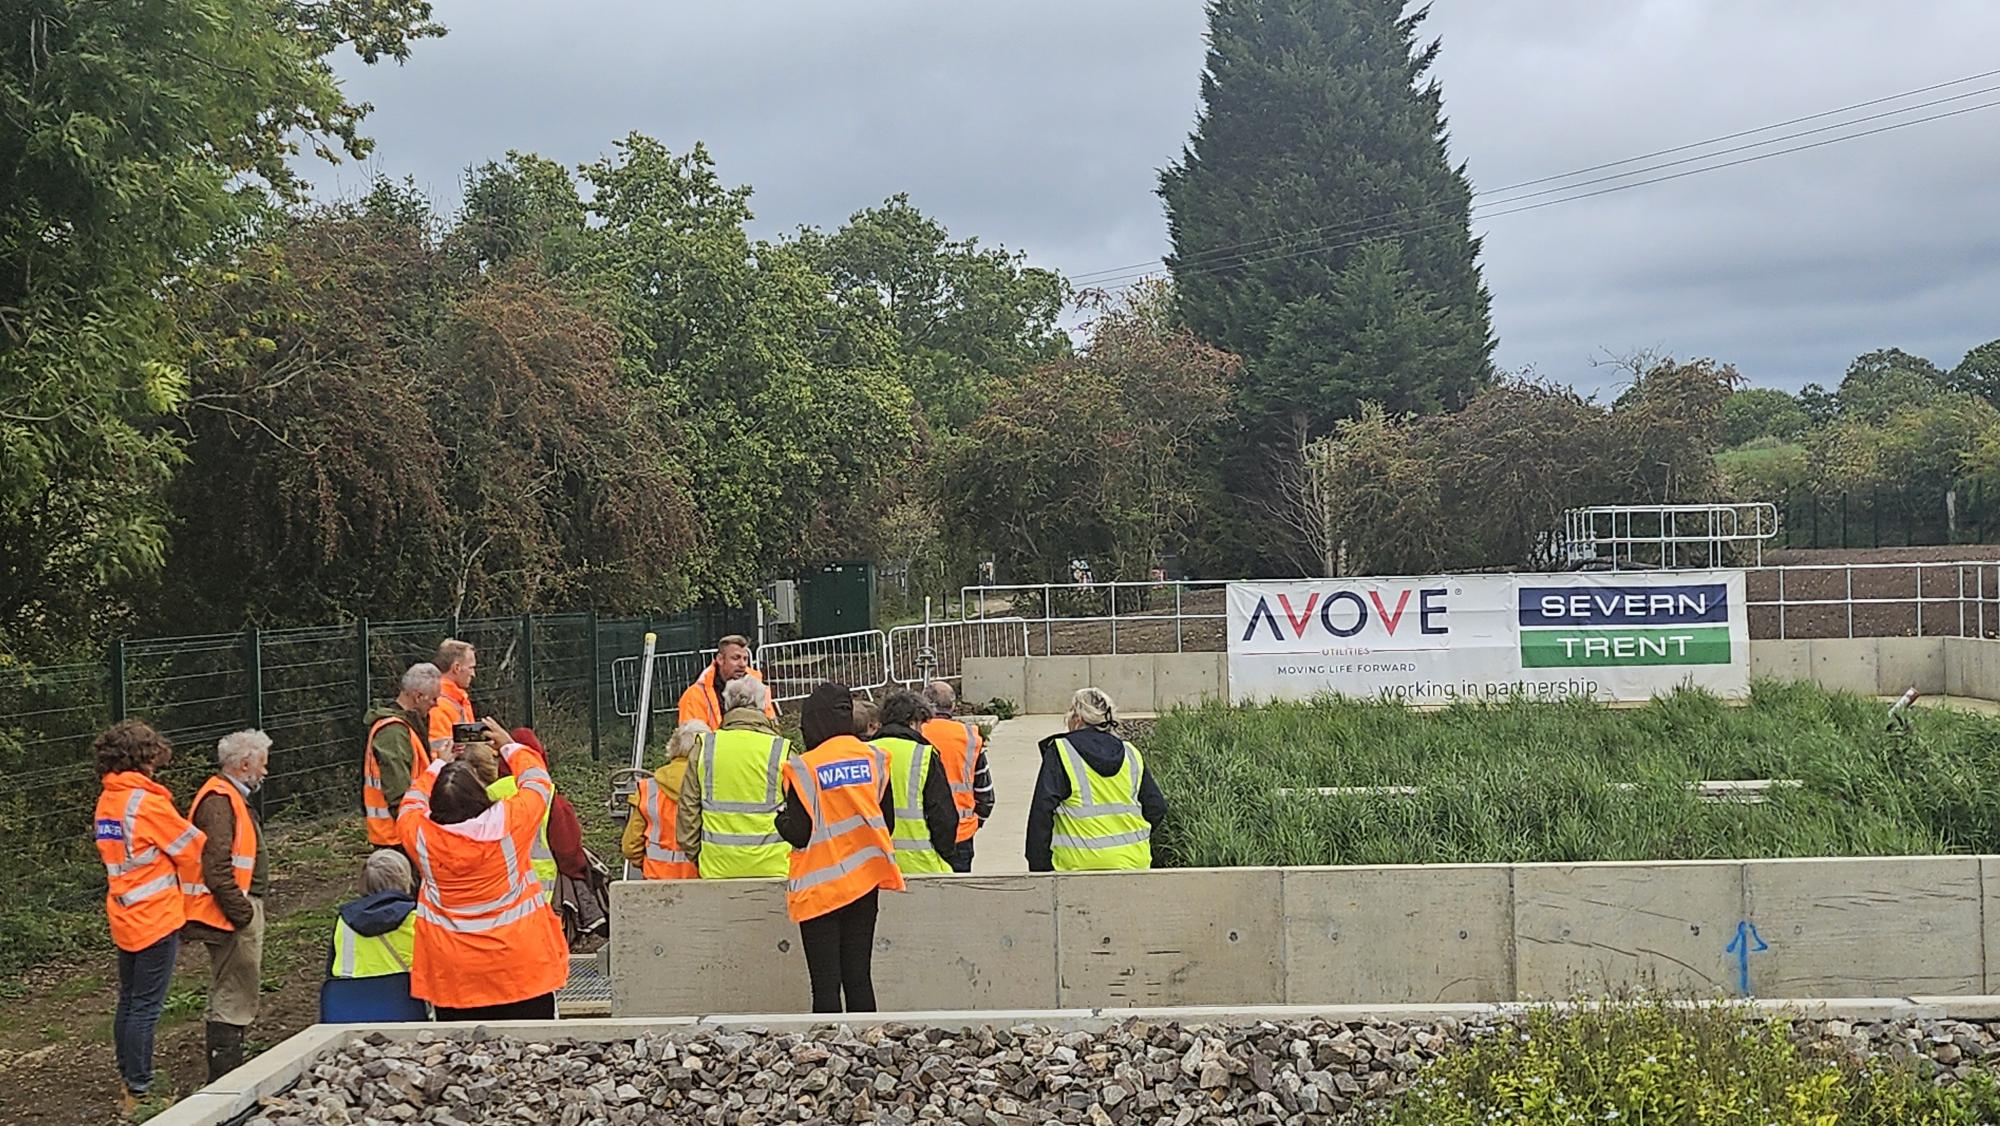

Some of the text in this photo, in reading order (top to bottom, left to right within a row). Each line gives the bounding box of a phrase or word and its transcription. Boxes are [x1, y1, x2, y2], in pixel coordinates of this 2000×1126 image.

[1242, 588, 1449, 641] AVOVE
[1541, 593, 1706, 617] SEVERN
[1321, 648, 1370, 656] UTILITIES
[1557, 635, 1694, 658] TRENT
[1277, 663, 1416, 674] MOVING LIFE FORWARD
[1379, 678, 1598, 699] working in partnership
[818, 765, 871, 784] WATER
